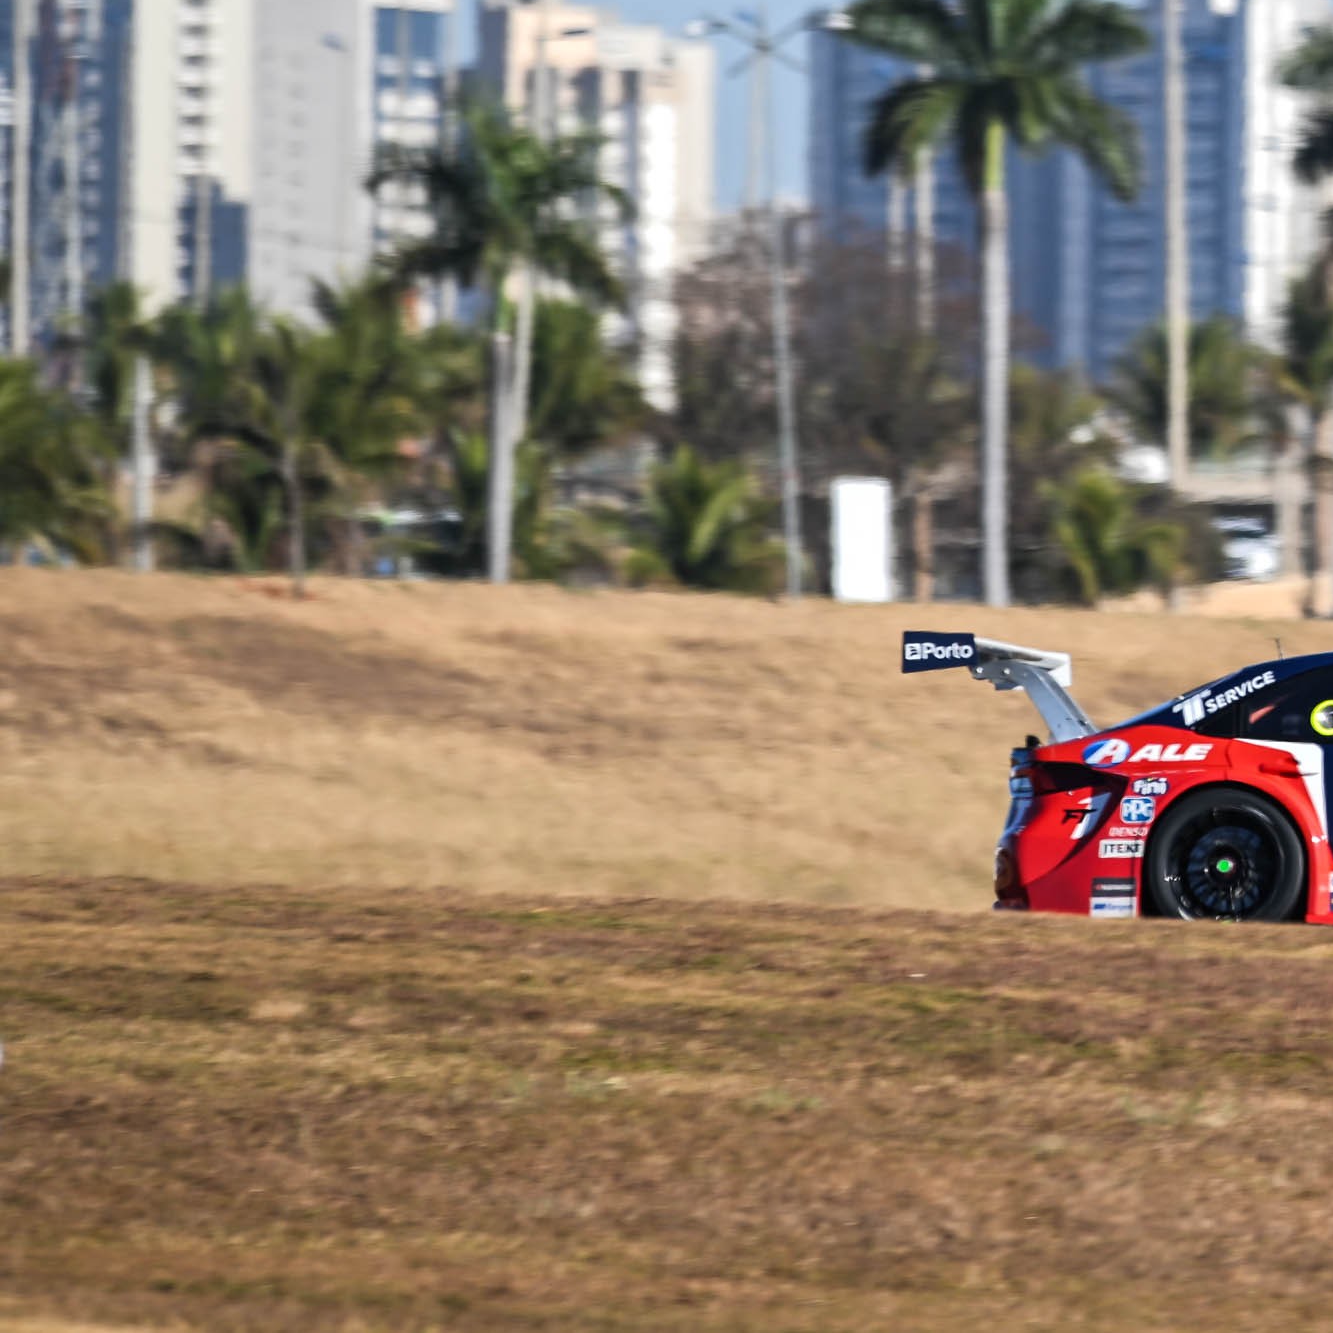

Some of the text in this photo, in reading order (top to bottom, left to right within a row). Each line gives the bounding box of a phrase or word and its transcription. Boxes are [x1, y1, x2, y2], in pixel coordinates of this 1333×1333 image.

[922, 642, 974, 659] Porto
[1205, 670, 1276, 714] SERVICE
[1127, 743, 1214, 762] ALE
